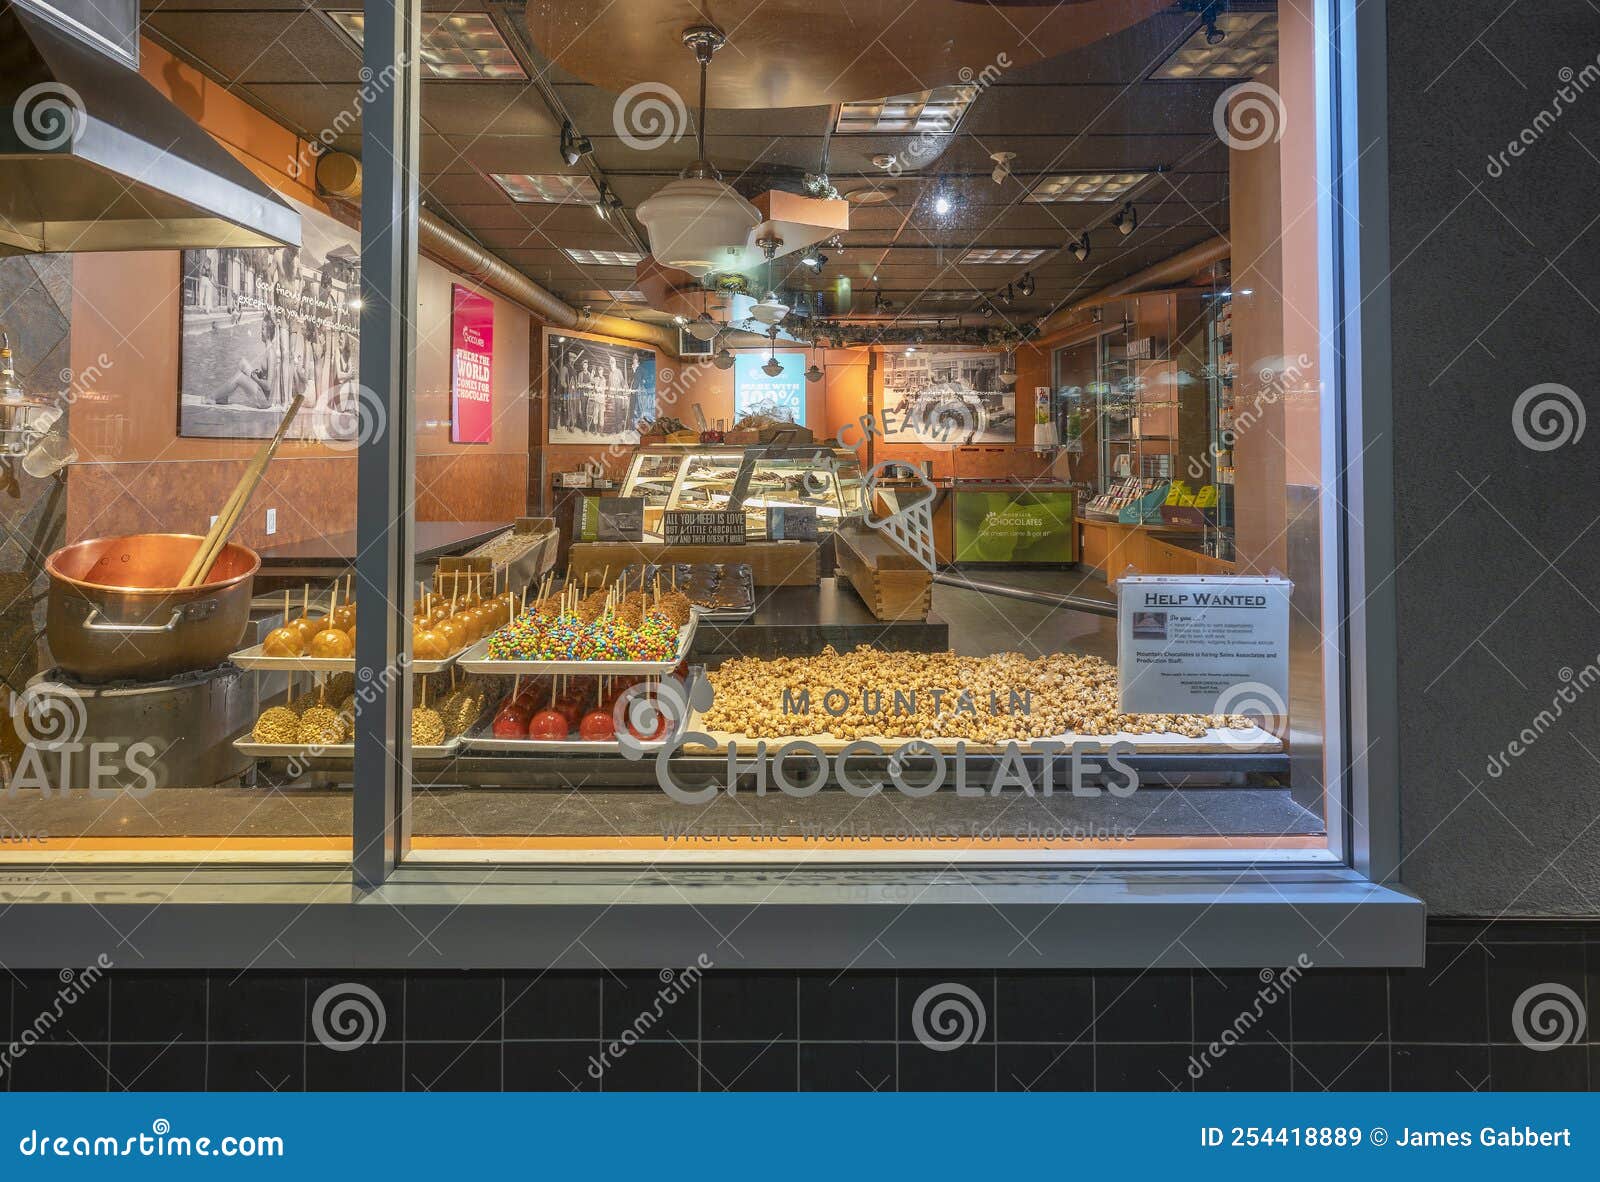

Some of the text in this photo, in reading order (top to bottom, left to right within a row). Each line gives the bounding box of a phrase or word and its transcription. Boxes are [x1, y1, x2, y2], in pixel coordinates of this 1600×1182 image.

[456, 349, 490, 367] WHERE THE
[457, 360, 490, 382] WORLD
[457, 378, 490, 393] COMES FOR
[457, 388, 490, 402] CHOCOLATE
[837, 407, 953, 450] CREAM
[667, 513, 745, 525] ALL YOU NEED IS LOVE
[990, 518, 1043, 526] CHOCOLATES
[666, 525, 678, 534] BUT
[686, 525, 706, 534] LITTLE
[709, 525, 745, 534] CHOCOLATE
[782, 688, 1033, 716] MOUNTAIN
[655, 731, 1139, 805] CHOCOLATES
[659, 819, 1138, 843] Where the World comes for chocolate
